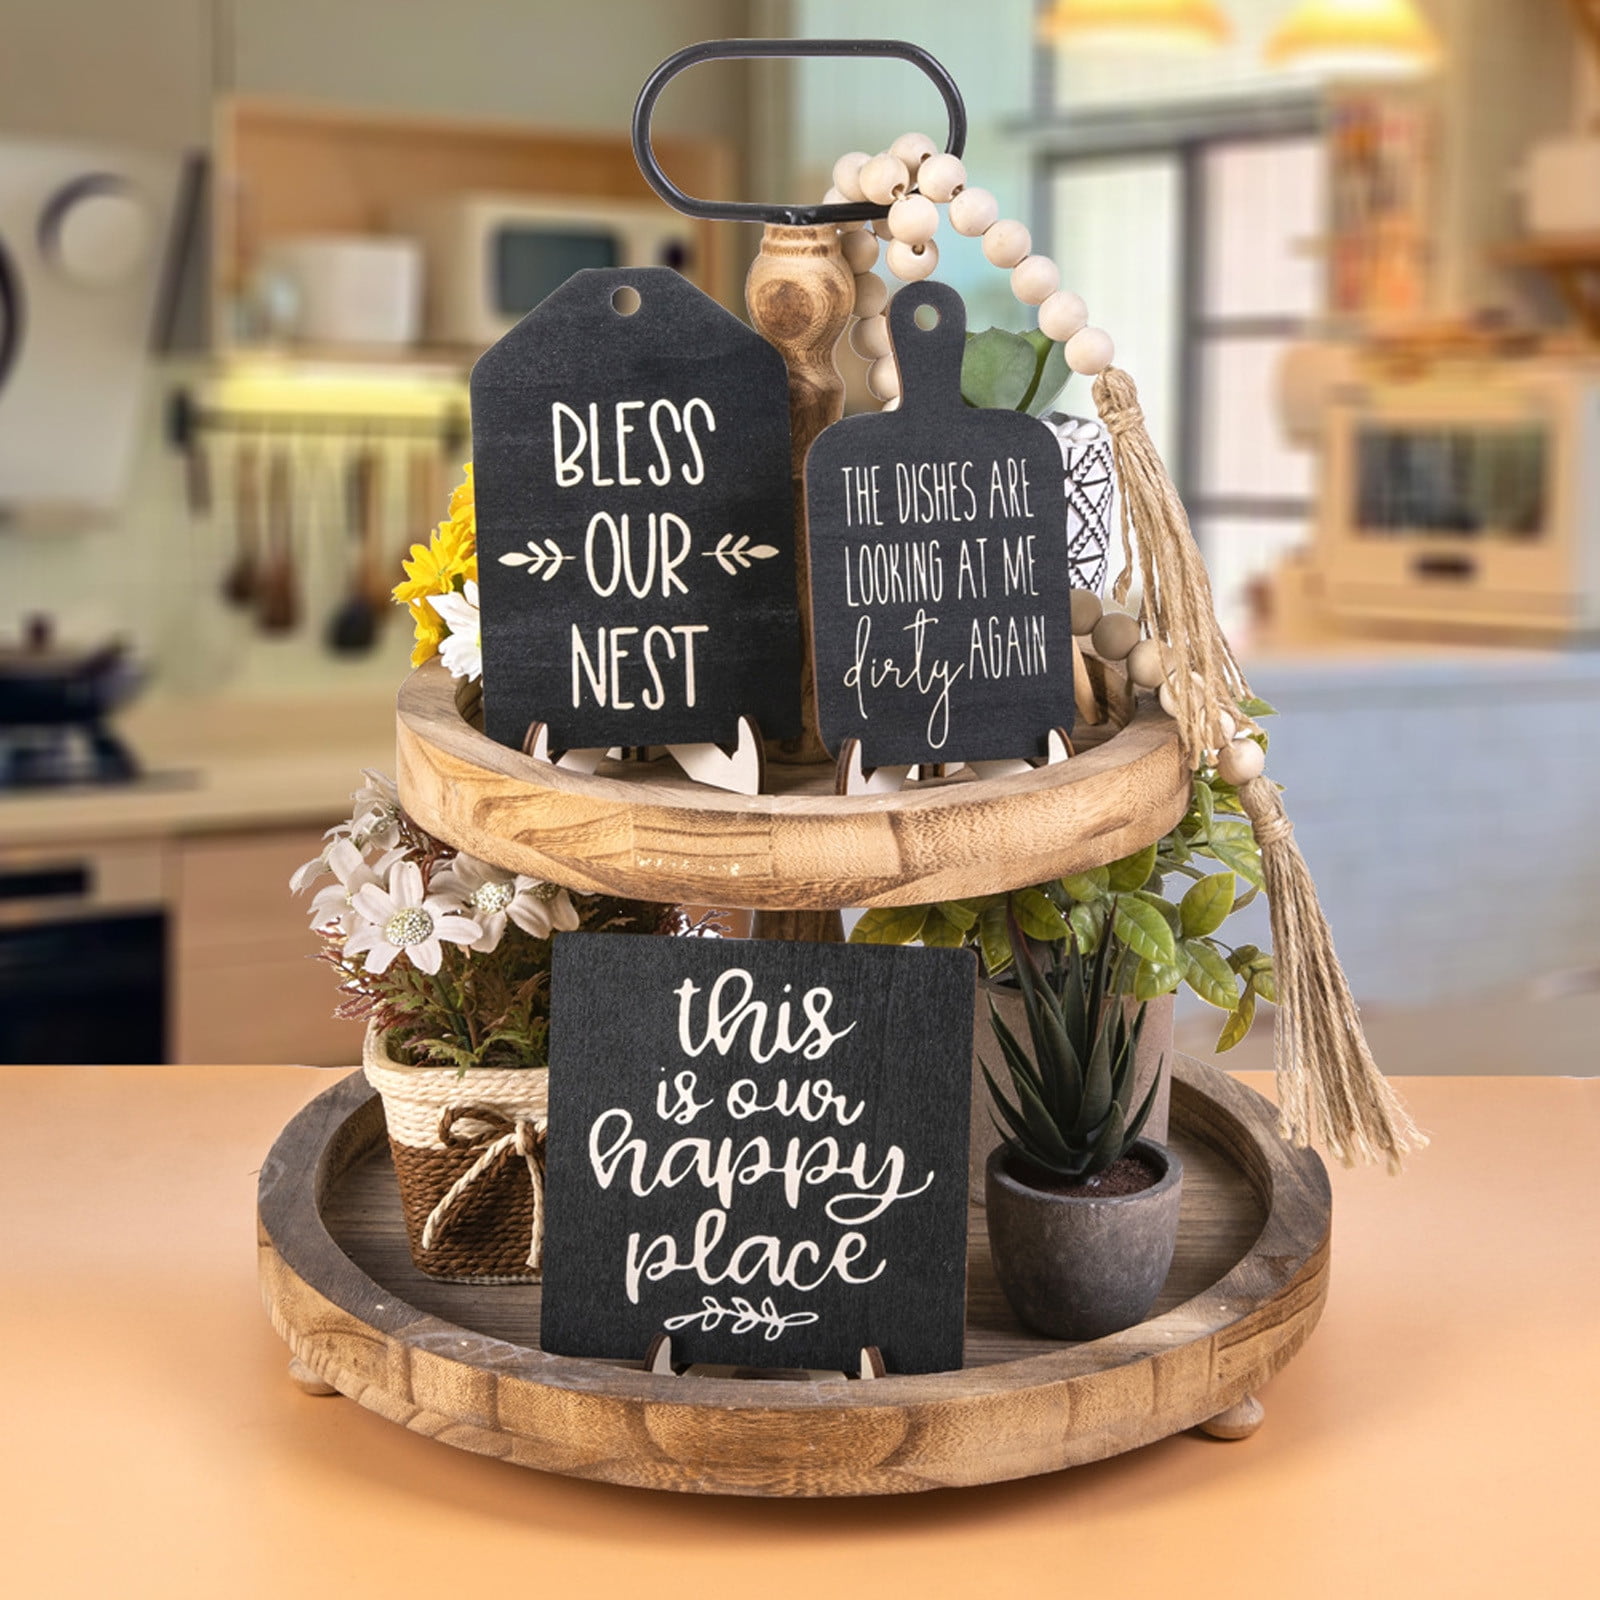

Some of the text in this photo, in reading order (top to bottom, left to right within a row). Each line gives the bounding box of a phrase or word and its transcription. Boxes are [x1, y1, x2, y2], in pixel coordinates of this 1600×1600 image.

[551, 397, 716, 488] BLESS
[841, 457, 1035, 527] THE DISHES ARE
[584, 510, 692, 600] OUR
[844, 534, 1039, 607] LOOKING AT ME
[571, 623, 710, 711] NEST
[843, 607, 1048, 750] dirty AGAIN
[672, 967, 857, 1064] this
[656, 1066, 866, 1126] is our
[588, 1107, 935, 1226] happy
[625, 1208, 887, 1305] place
